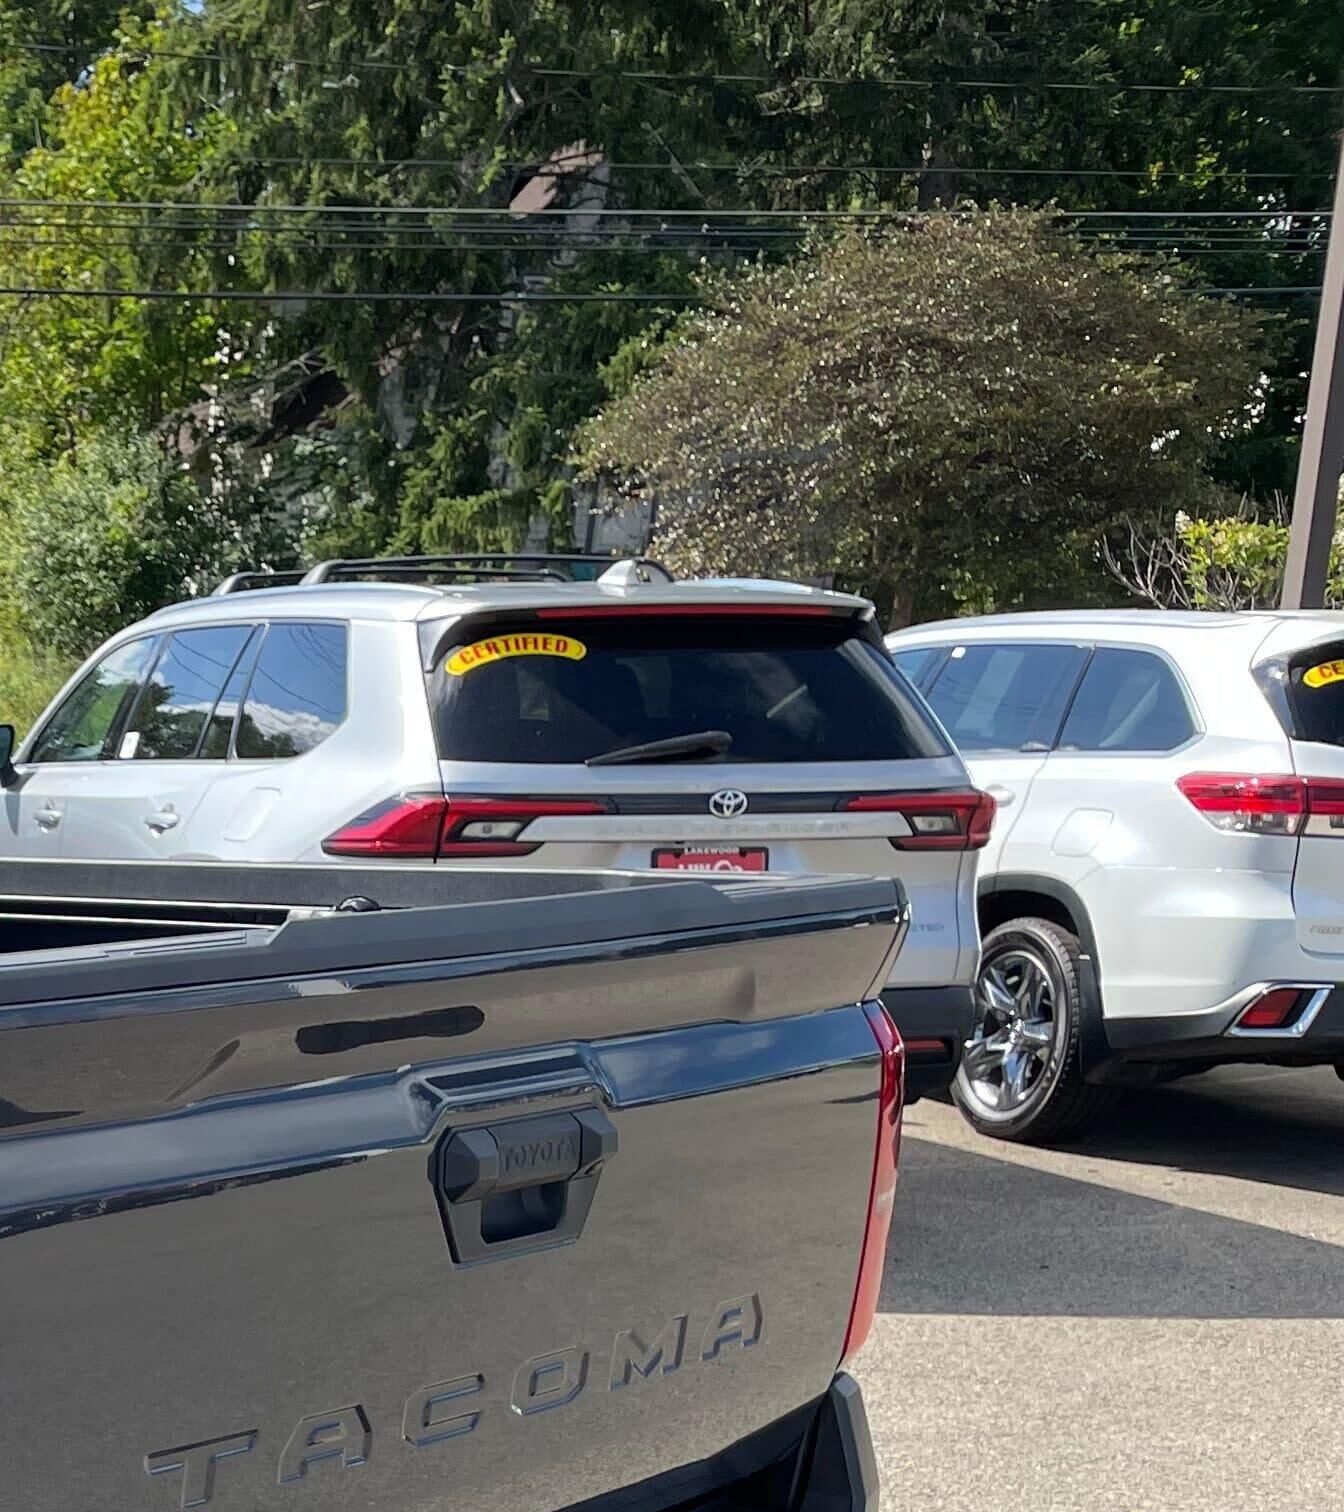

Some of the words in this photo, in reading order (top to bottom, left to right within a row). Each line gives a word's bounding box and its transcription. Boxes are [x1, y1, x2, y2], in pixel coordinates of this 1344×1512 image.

[458, 636, 570, 665] CERTIFIED
[500, 1135, 577, 1174] TOYOTA
[143, 1291, 764, 1510] TACOMA
